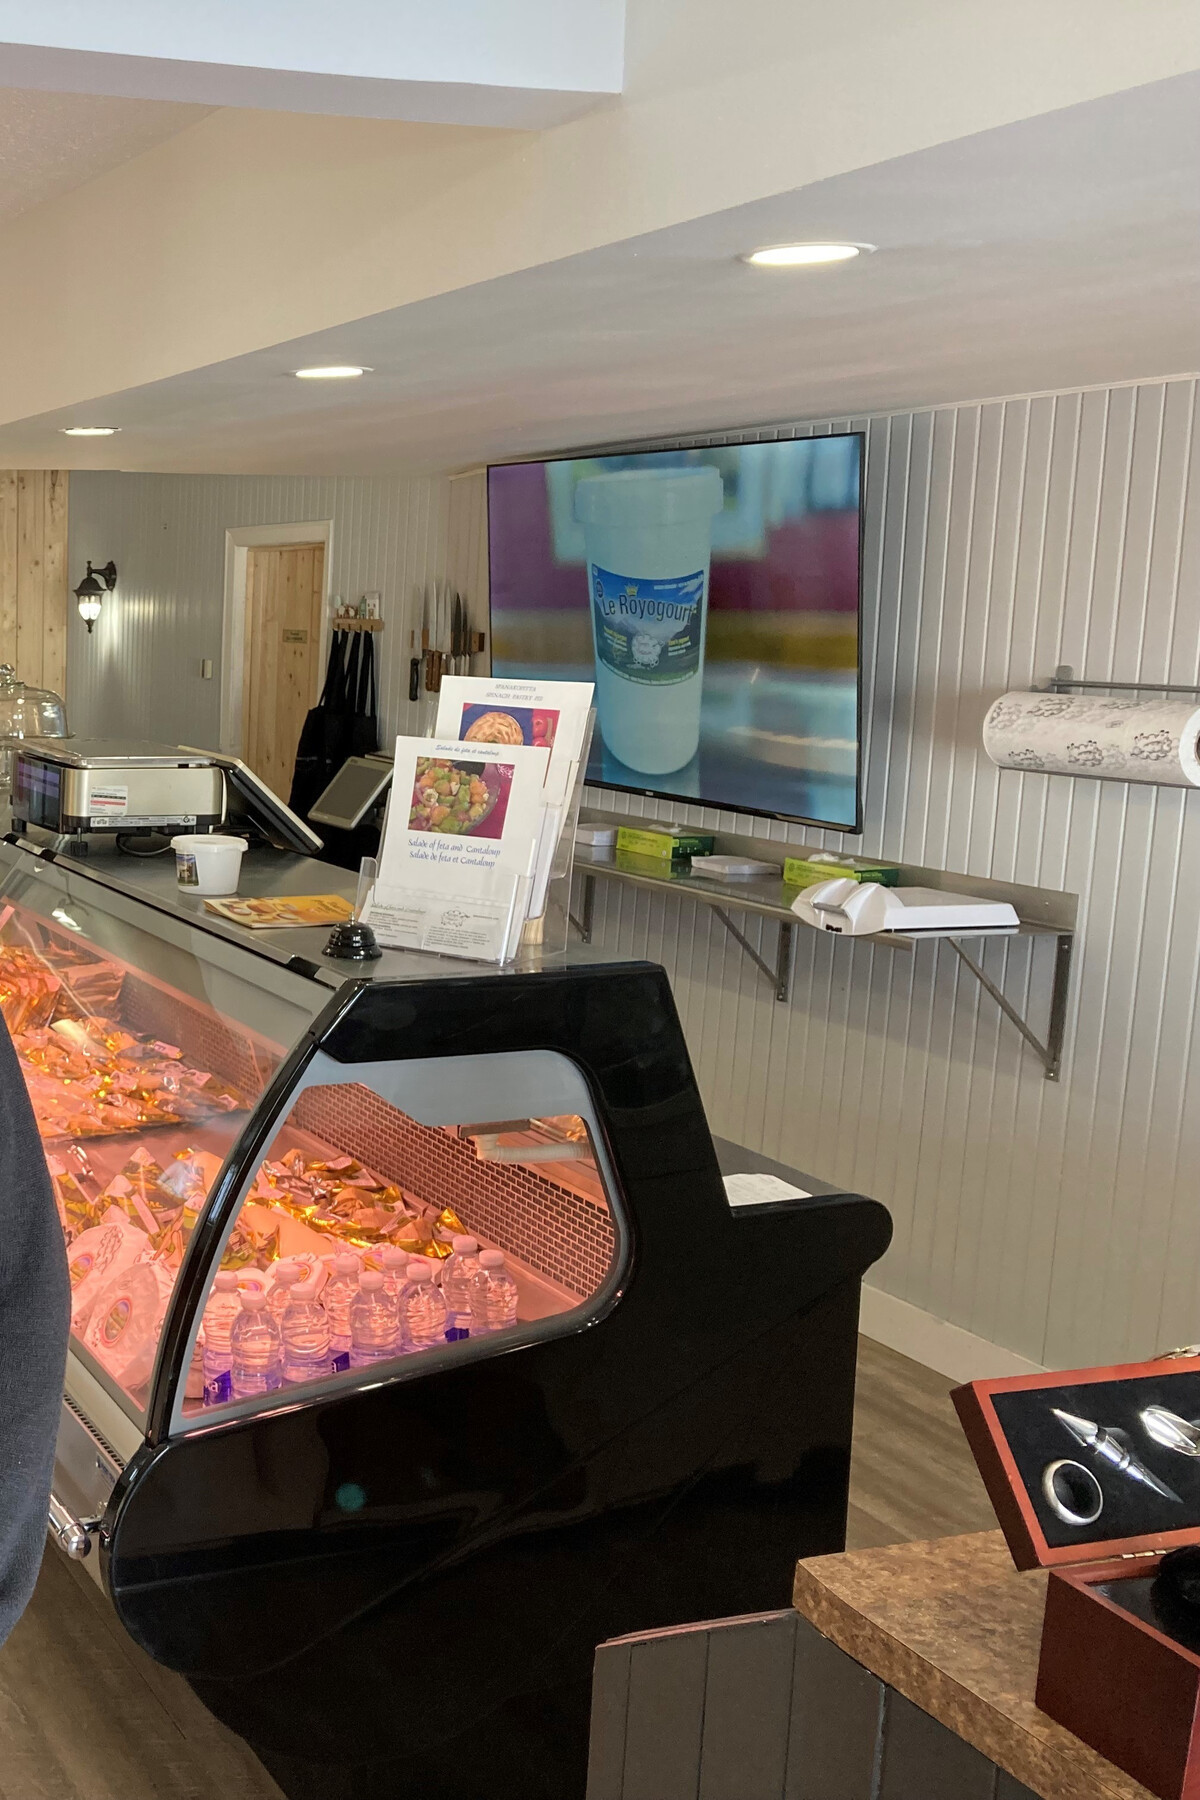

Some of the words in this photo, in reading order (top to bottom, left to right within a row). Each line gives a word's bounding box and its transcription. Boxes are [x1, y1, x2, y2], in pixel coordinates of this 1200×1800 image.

[602, 599, 616, 616] Le
[618, 594, 694, 624] Royogourt
[408, 836, 428, 848] Salade
[429, 839, 437, 850] of
[436, 839, 450, 852] feta
[450, 843, 463, 852] and
[466, 845, 501, 858] Cantaloup
[409, 848, 429, 860] Salade
[430, 851, 437, 861] de
[438, 851, 452, 864] feta
[452, 855, 459, 864] et
[460, 856, 496, 870] Cantaloup
